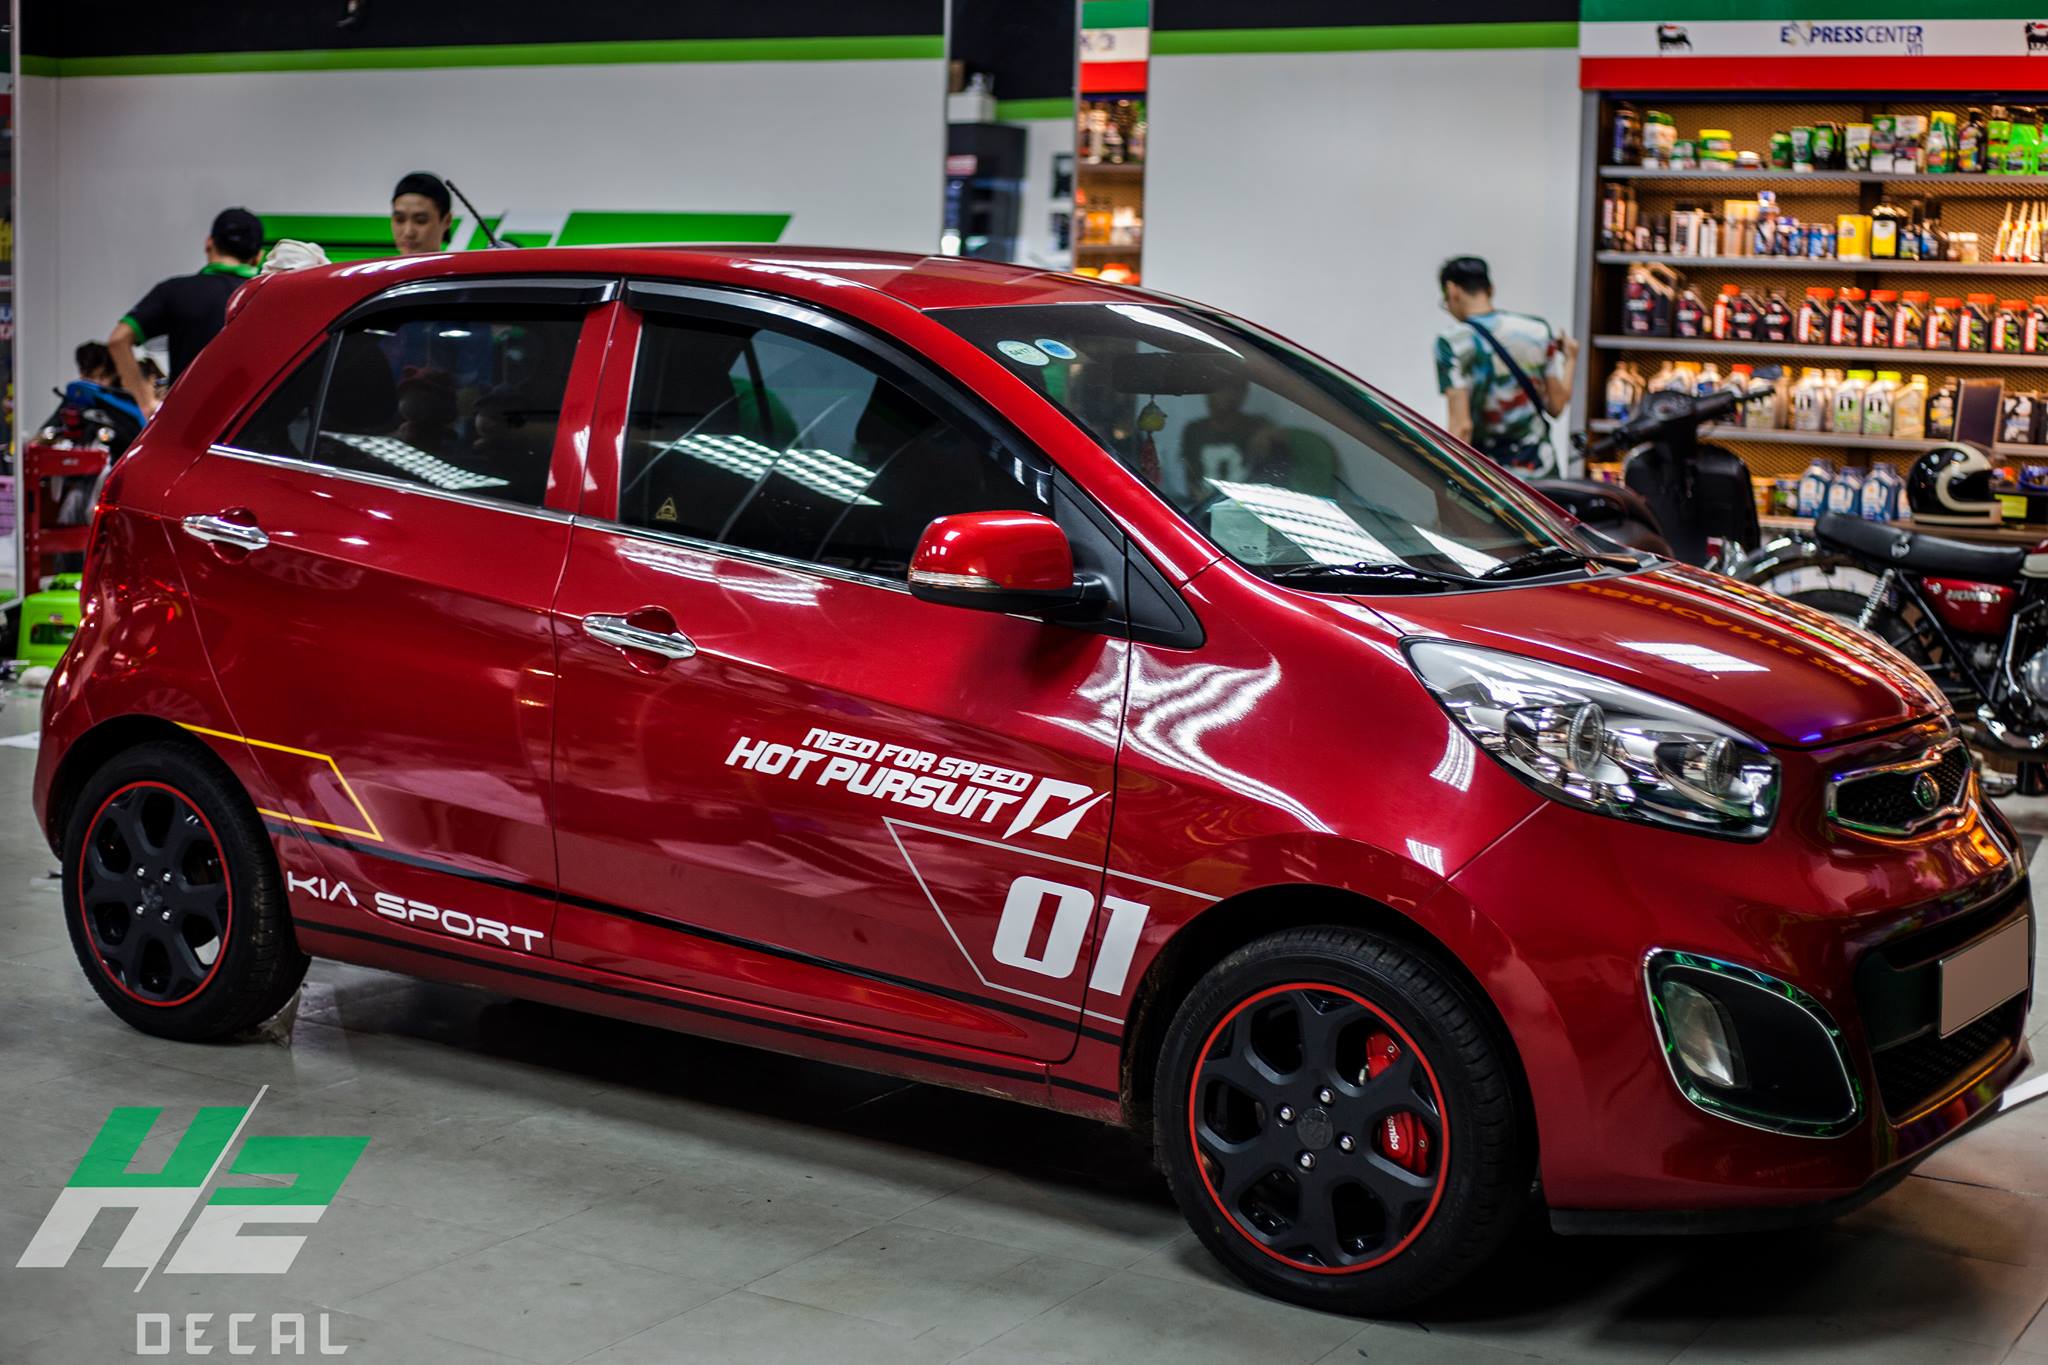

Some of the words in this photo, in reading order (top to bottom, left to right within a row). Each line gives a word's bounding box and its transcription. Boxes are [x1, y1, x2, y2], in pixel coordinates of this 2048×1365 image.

[724, 736, 828, 780] HOT
[816, 763, 1023, 823] PURSUIT
[802, 727, 880, 760] NEED
[877, 743, 933, 772] FOR
[932, 756, 1034, 792] SPEED
[286, 870, 358, 907] KIA
[374, 891, 545, 951] SPORT
[991, 875, 1151, 996] 01
